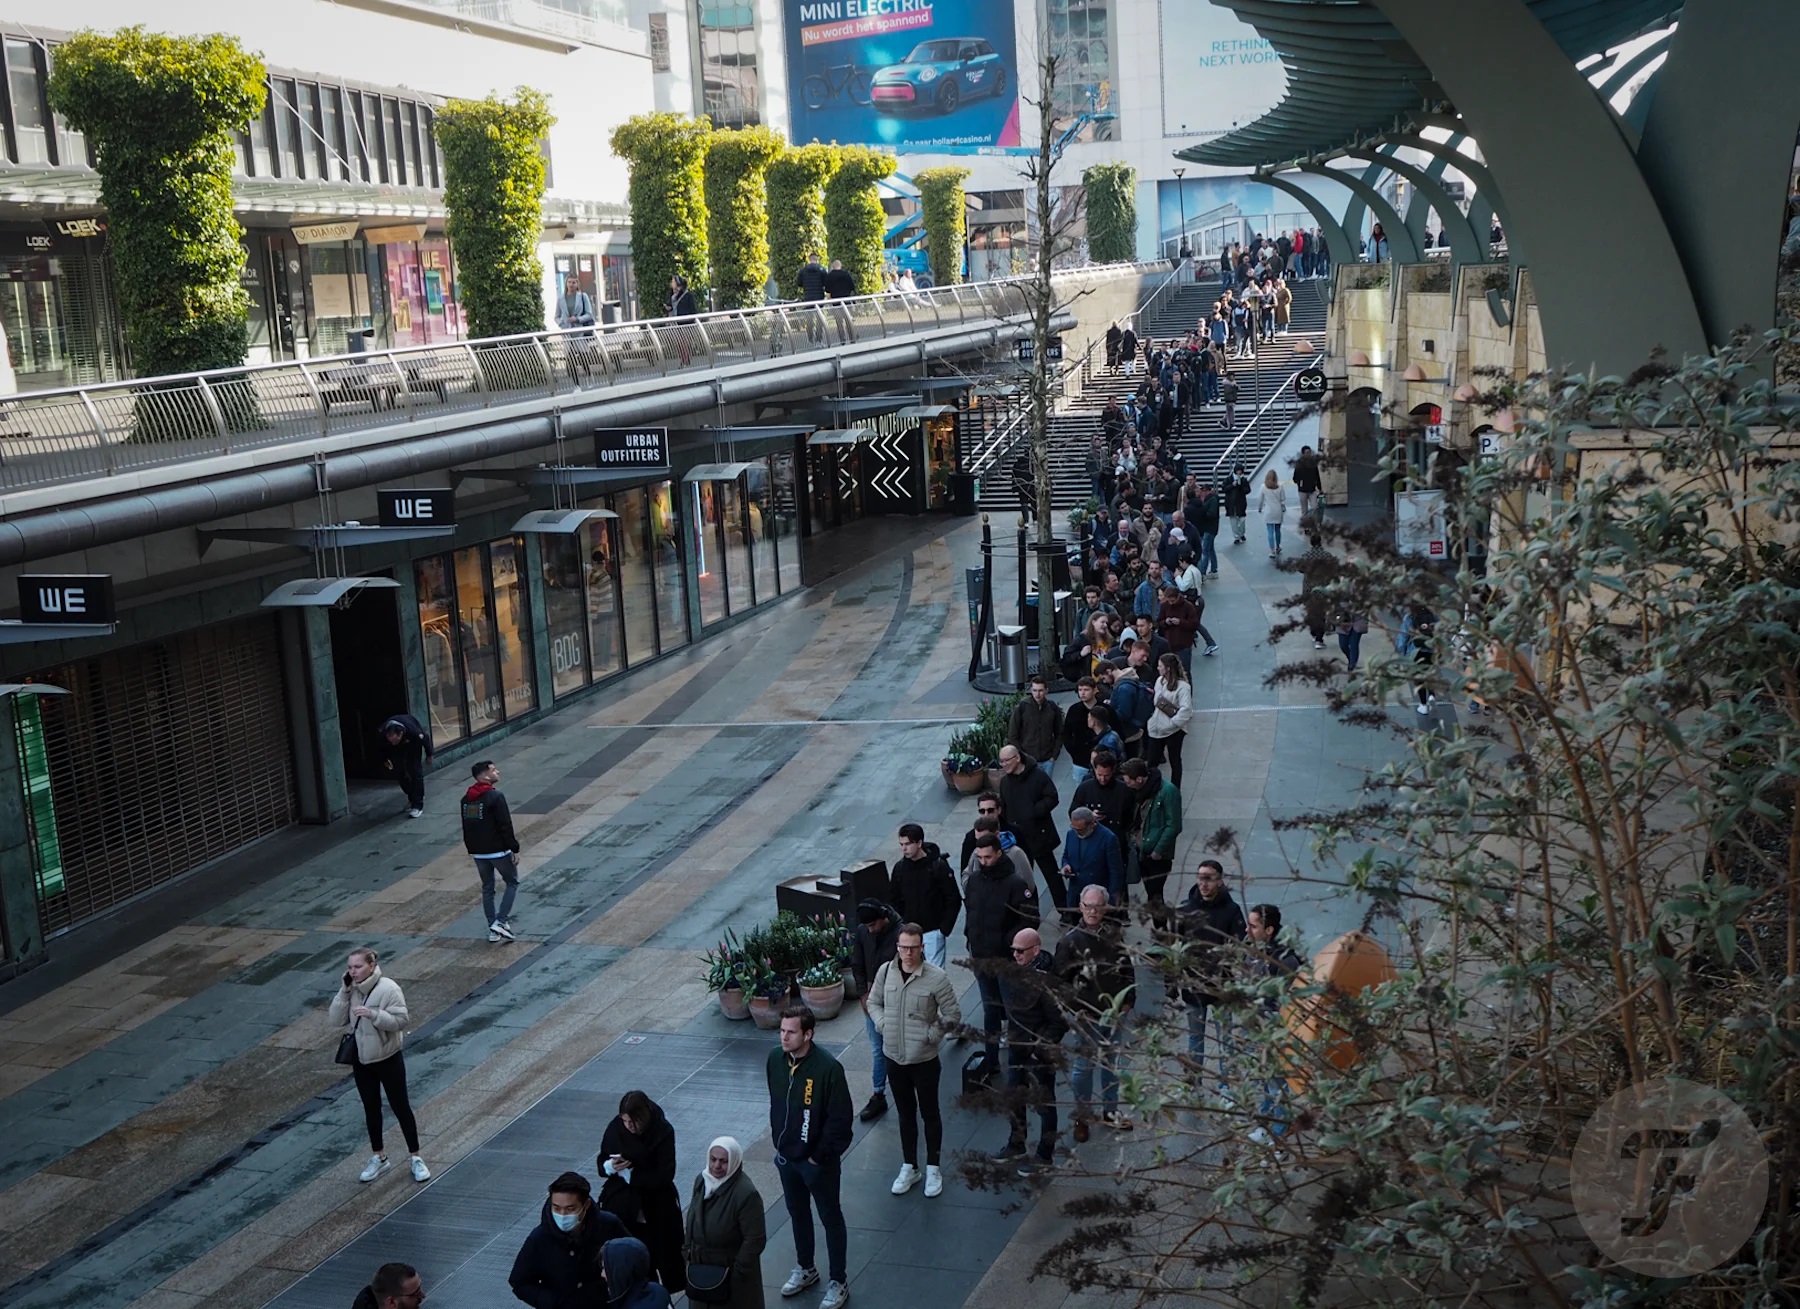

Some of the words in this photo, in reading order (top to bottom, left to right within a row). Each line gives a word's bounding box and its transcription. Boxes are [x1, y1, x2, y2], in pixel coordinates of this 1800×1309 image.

[800, 3, 841, 22] MINI
[846, 0, 933, 17] ELECTRIC
[804, 29, 820, 41] Nu
[822, 24, 853, 38] wordt
[856, 21, 874, 33] het
[877, 11, 929, 31] spannend
[1200, 54, 1235, 67] NEXT
[310, 226, 348, 239] DIAMOR
[1022, 348, 1059, 358] OUTERS
[625, 434, 659, 447] URBAN
[1482, 438, 1492, 453] P
[601, 449, 660, 462] OUTFITTERS
[395, 499, 433, 518] WE
[39, 588, 86, 612] WE
[554, 632, 580, 673] BDG
[491, 682, 532, 711] OUFITTERS
[804, 1079, 813, 1105] POLO
[800, 1109, 810, 1143] SPORT
